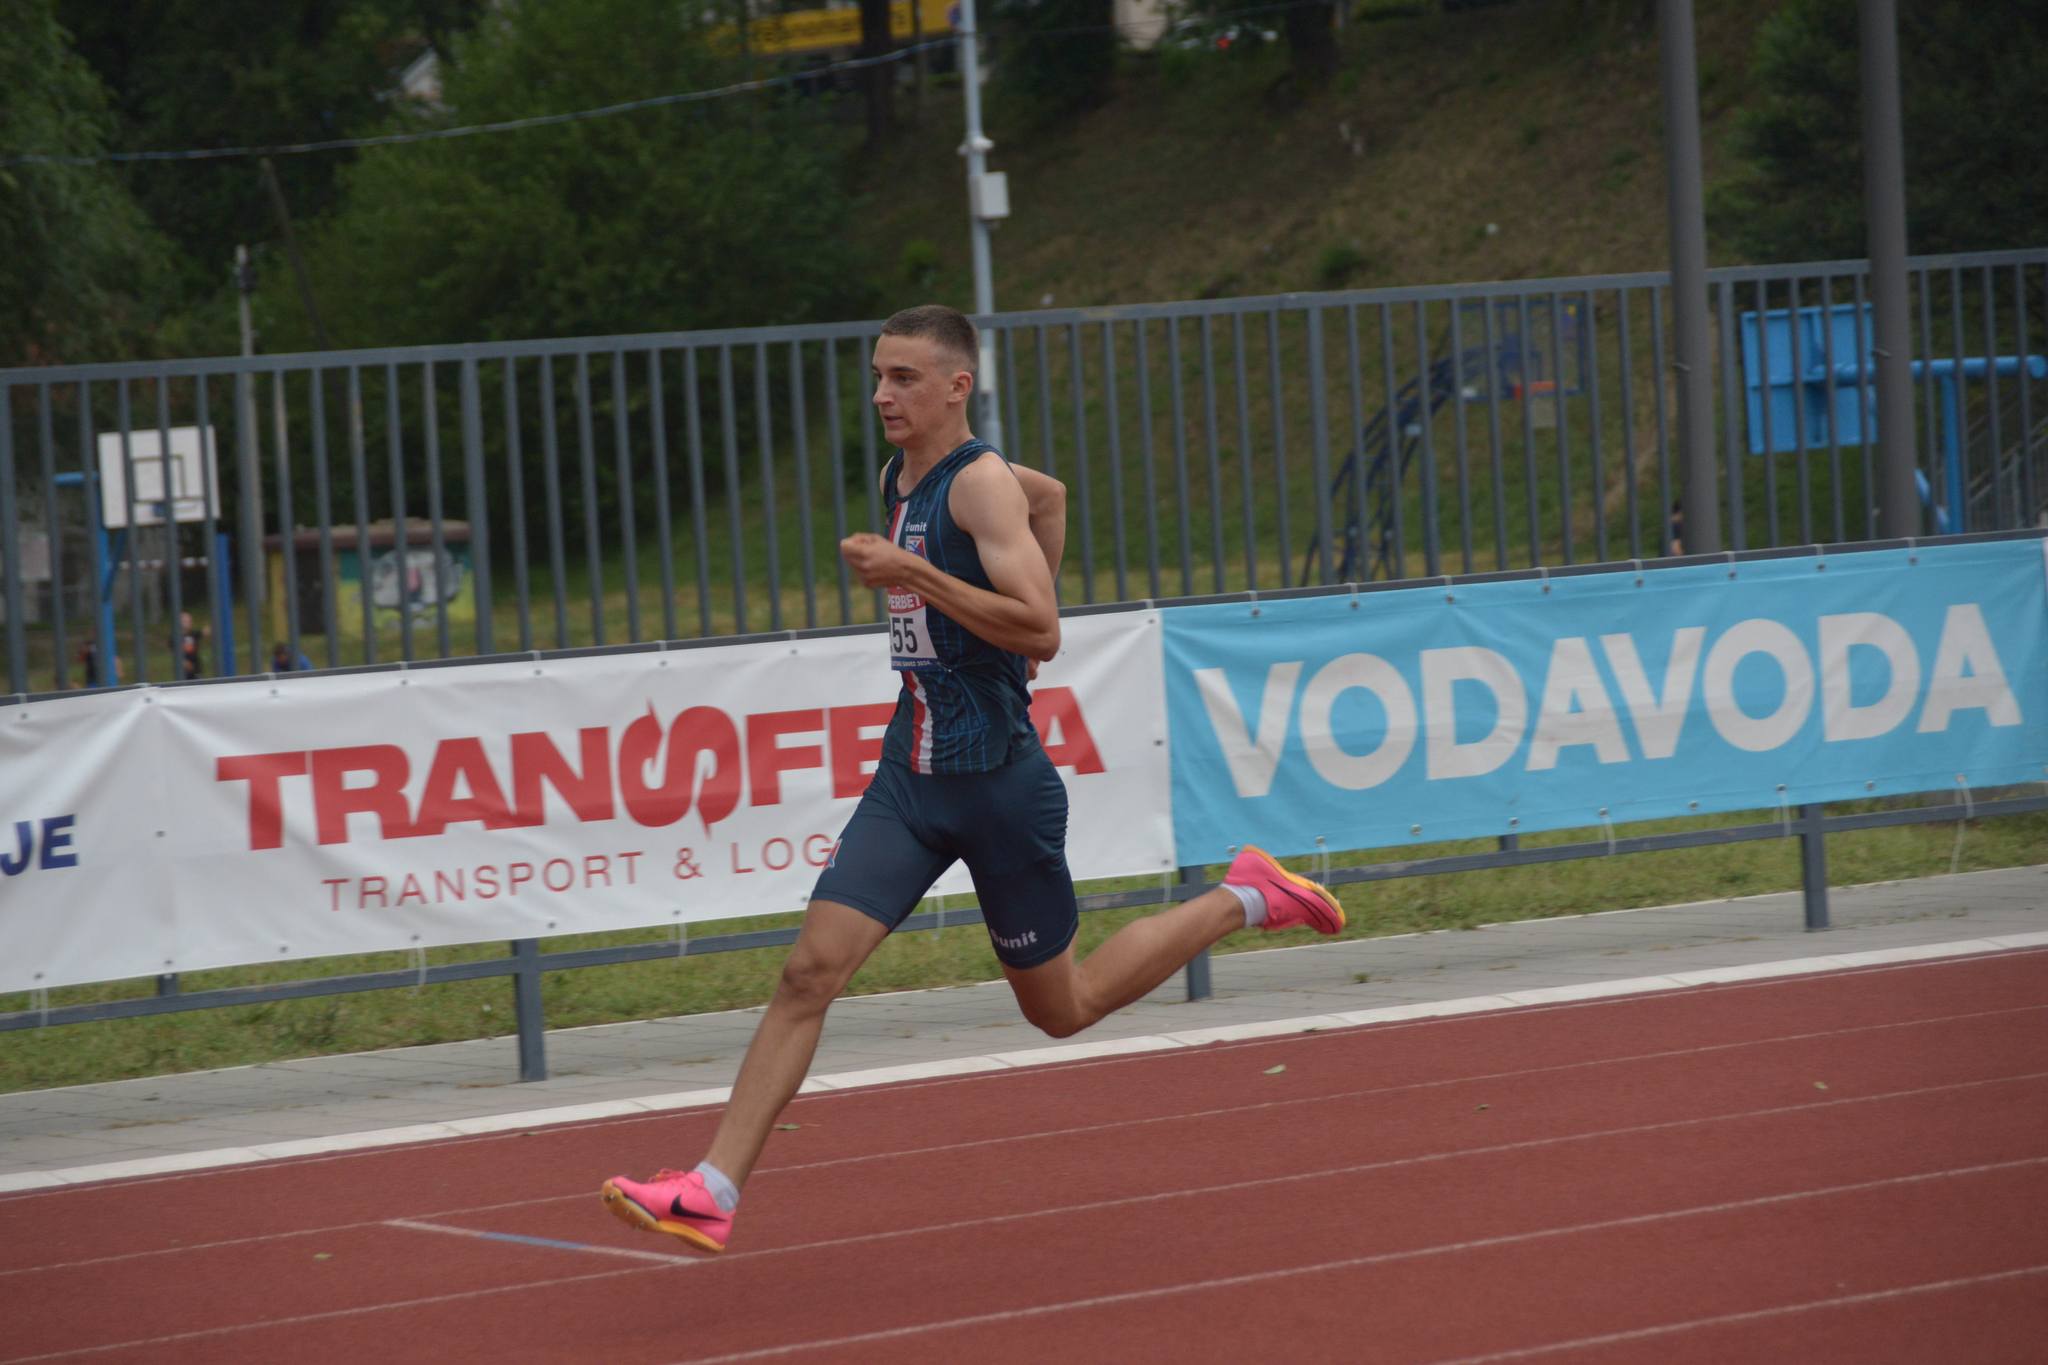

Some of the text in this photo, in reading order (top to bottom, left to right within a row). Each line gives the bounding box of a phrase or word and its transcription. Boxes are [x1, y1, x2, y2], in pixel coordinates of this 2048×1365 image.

[889, 617, 918, 654] 55
[1194, 604, 2023, 798] VODAVODA
[216, 686, 1107, 851] TRANSFEA
[322, 851, 644, 911] TRANSPORT
[674, 846, 703, 880] &
